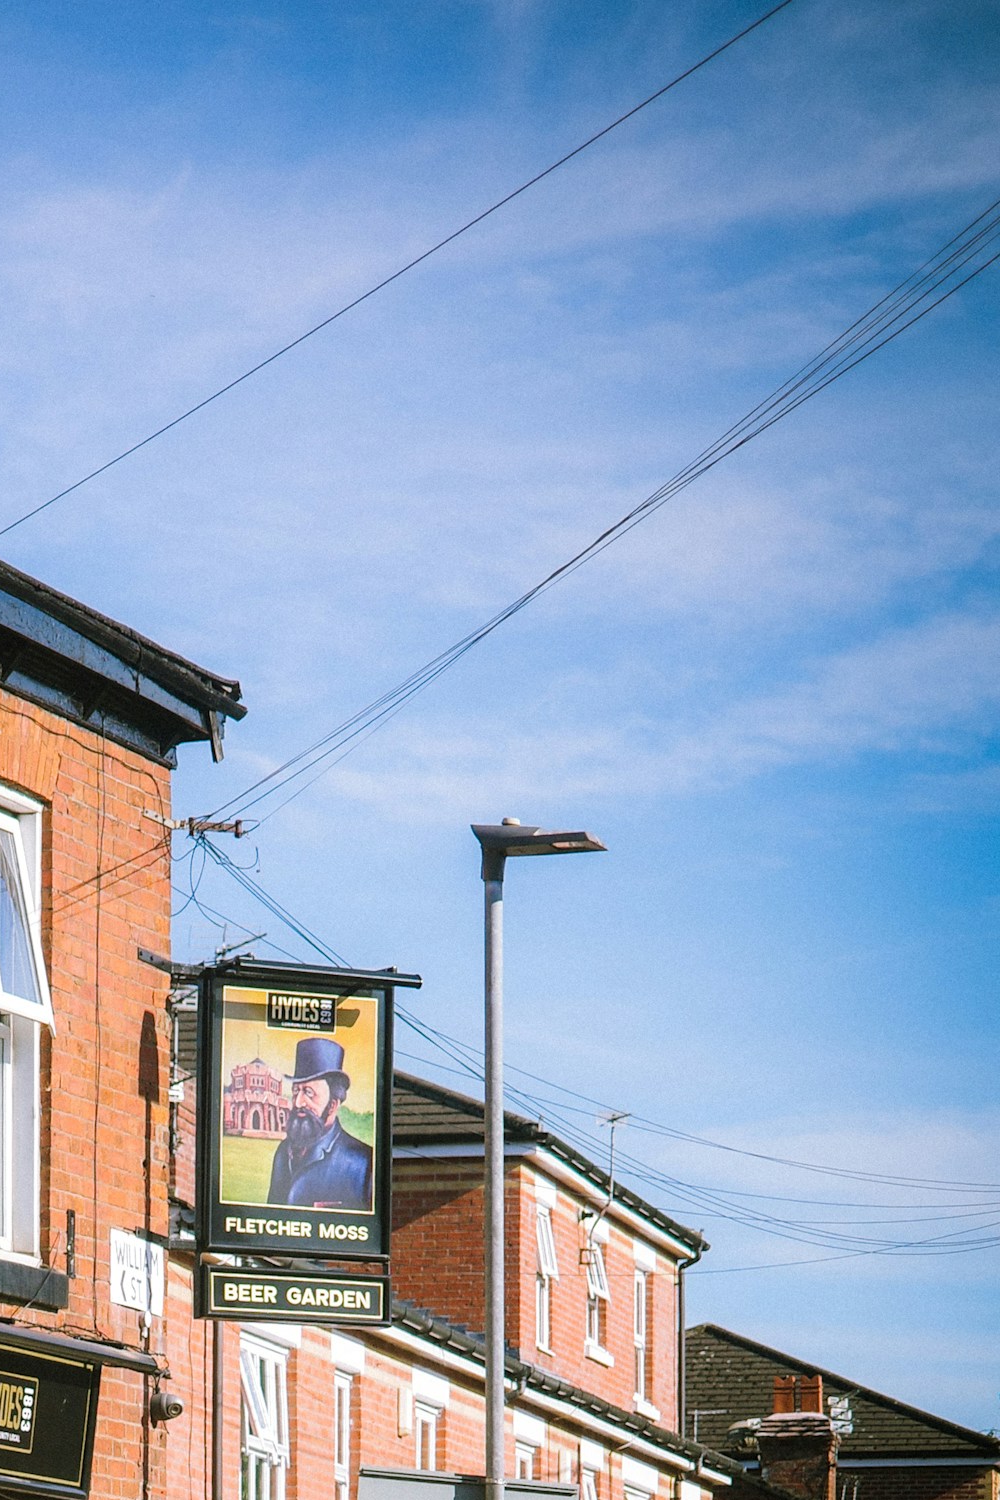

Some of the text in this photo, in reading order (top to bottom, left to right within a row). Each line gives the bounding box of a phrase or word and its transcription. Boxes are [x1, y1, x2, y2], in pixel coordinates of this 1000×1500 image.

[271, 995, 320, 1023] HYDES
[320, 999, 333, 1024] 1863
[225, 1216, 369, 1241] FLETCHER MOSS
[115, 1240, 159, 1278] WILLIAM
[224, 1283, 371, 1309] BEER GARDEN
[20, 1387, 35, 1432] 1863
